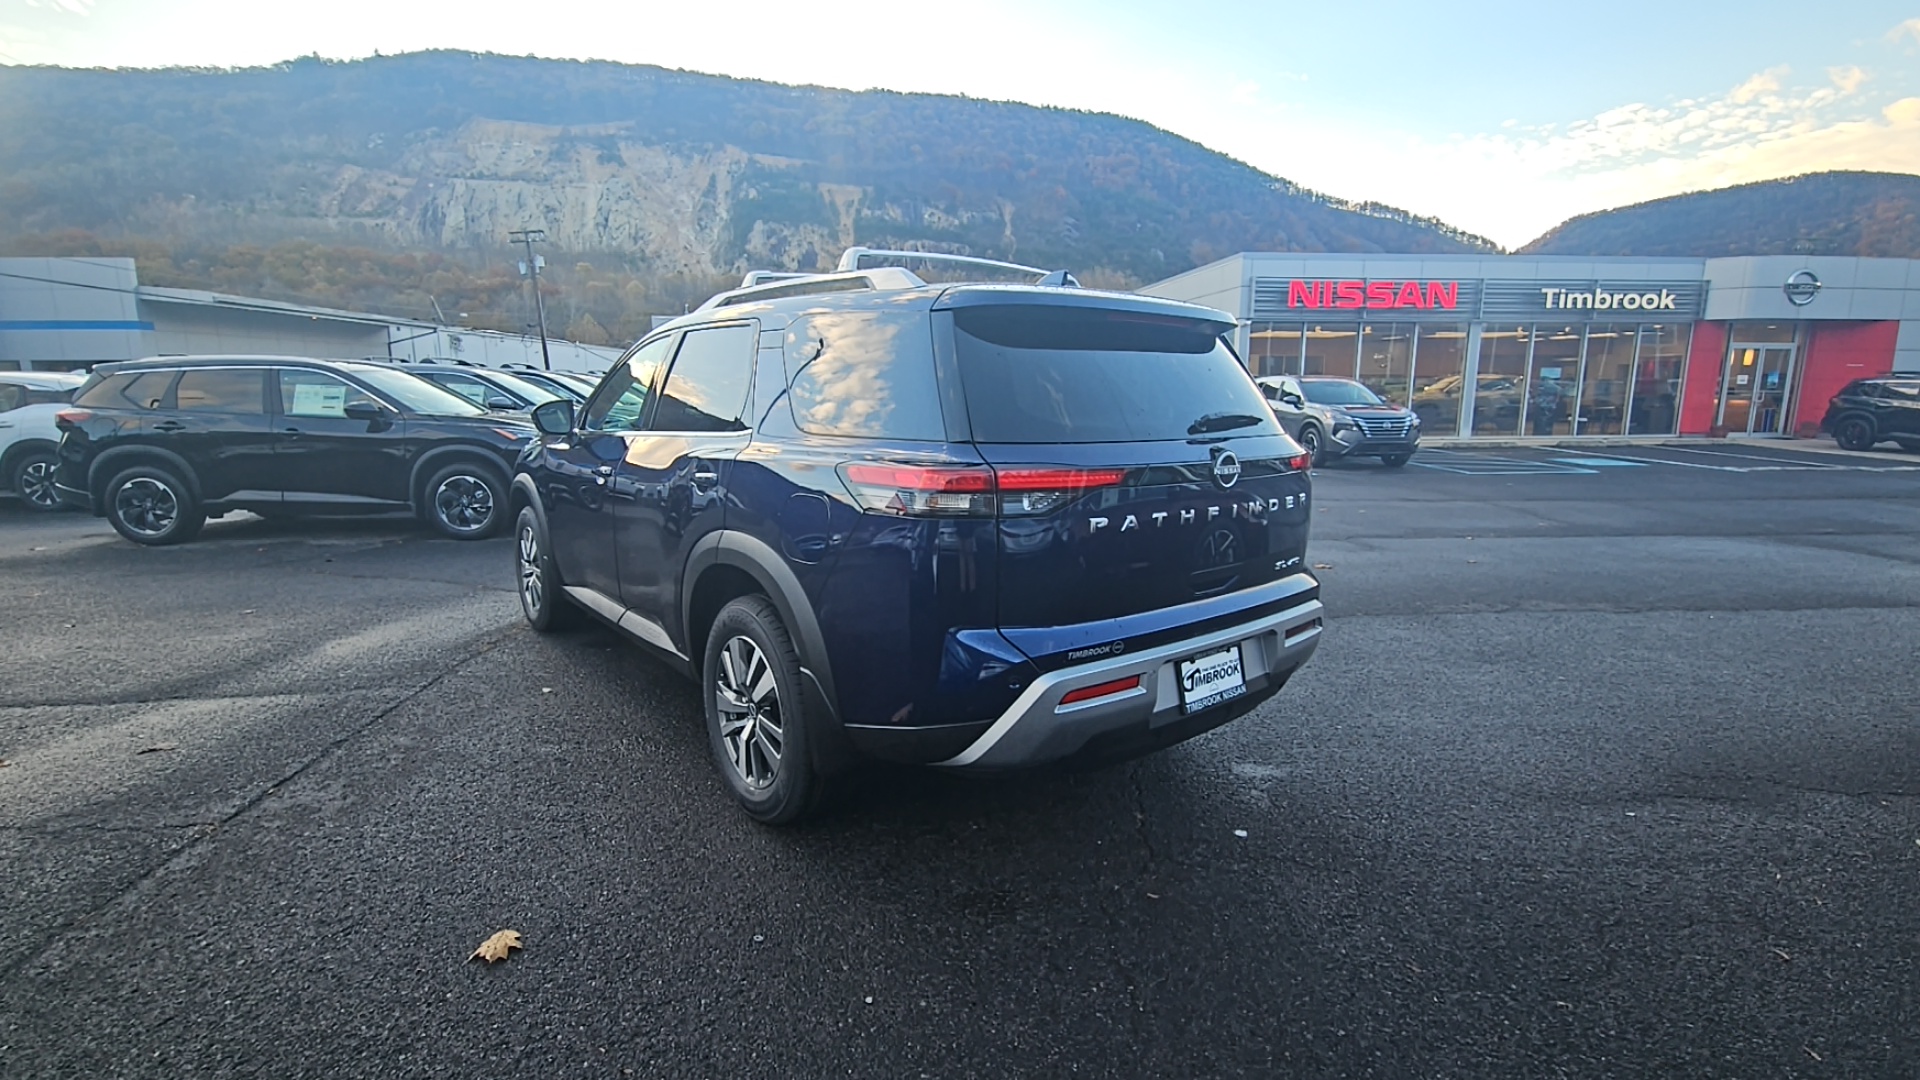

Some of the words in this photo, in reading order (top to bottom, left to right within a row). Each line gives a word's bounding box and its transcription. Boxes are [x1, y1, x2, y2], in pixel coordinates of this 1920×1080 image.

[1288, 280, 1458, 310] NISSAN
[1541, 288, 1677, 310] Timbrook
[1089, 492, 1306, 533] PATHFINDER
[1068, 645, 1112, 660] TIMBROOK
[1183, 663, 1240, 692] TIMBROOK
[1186, 693, 1222, 714] TIMBROOK
[1222, 684, 1246, 700] NISSAN
